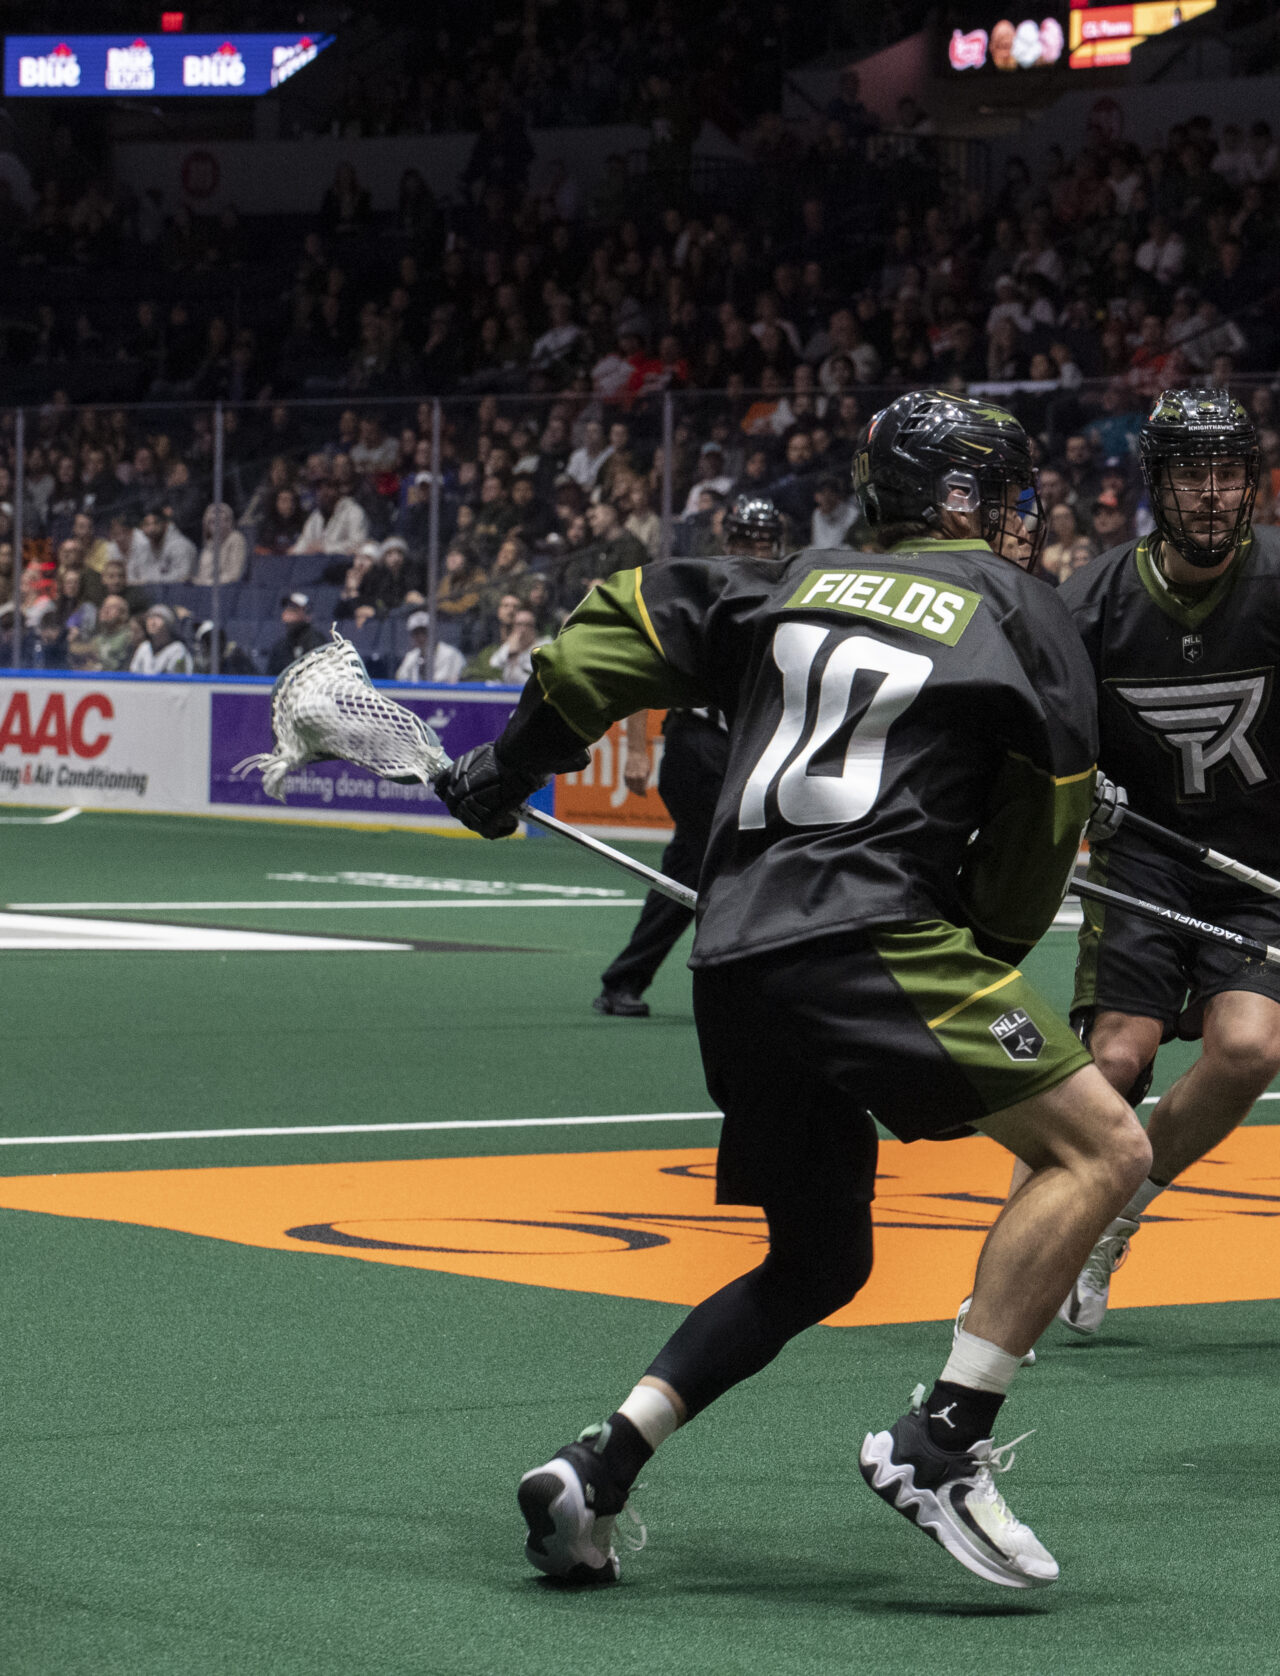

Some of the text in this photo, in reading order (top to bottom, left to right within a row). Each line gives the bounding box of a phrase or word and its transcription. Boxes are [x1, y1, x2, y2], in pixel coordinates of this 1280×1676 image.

[801, 573, 965, 635] FIELDS
[0, 691, 114, 760] AAC
[738, 622, 934, 830] 10
[35, 764, 54, 785] Air
[57, 763, 148, 796] Conditioning
[283, 769, 334, 803] anking
[335, 770, 376, 798] done
[993, 1013, 1027, 1036] NLL
